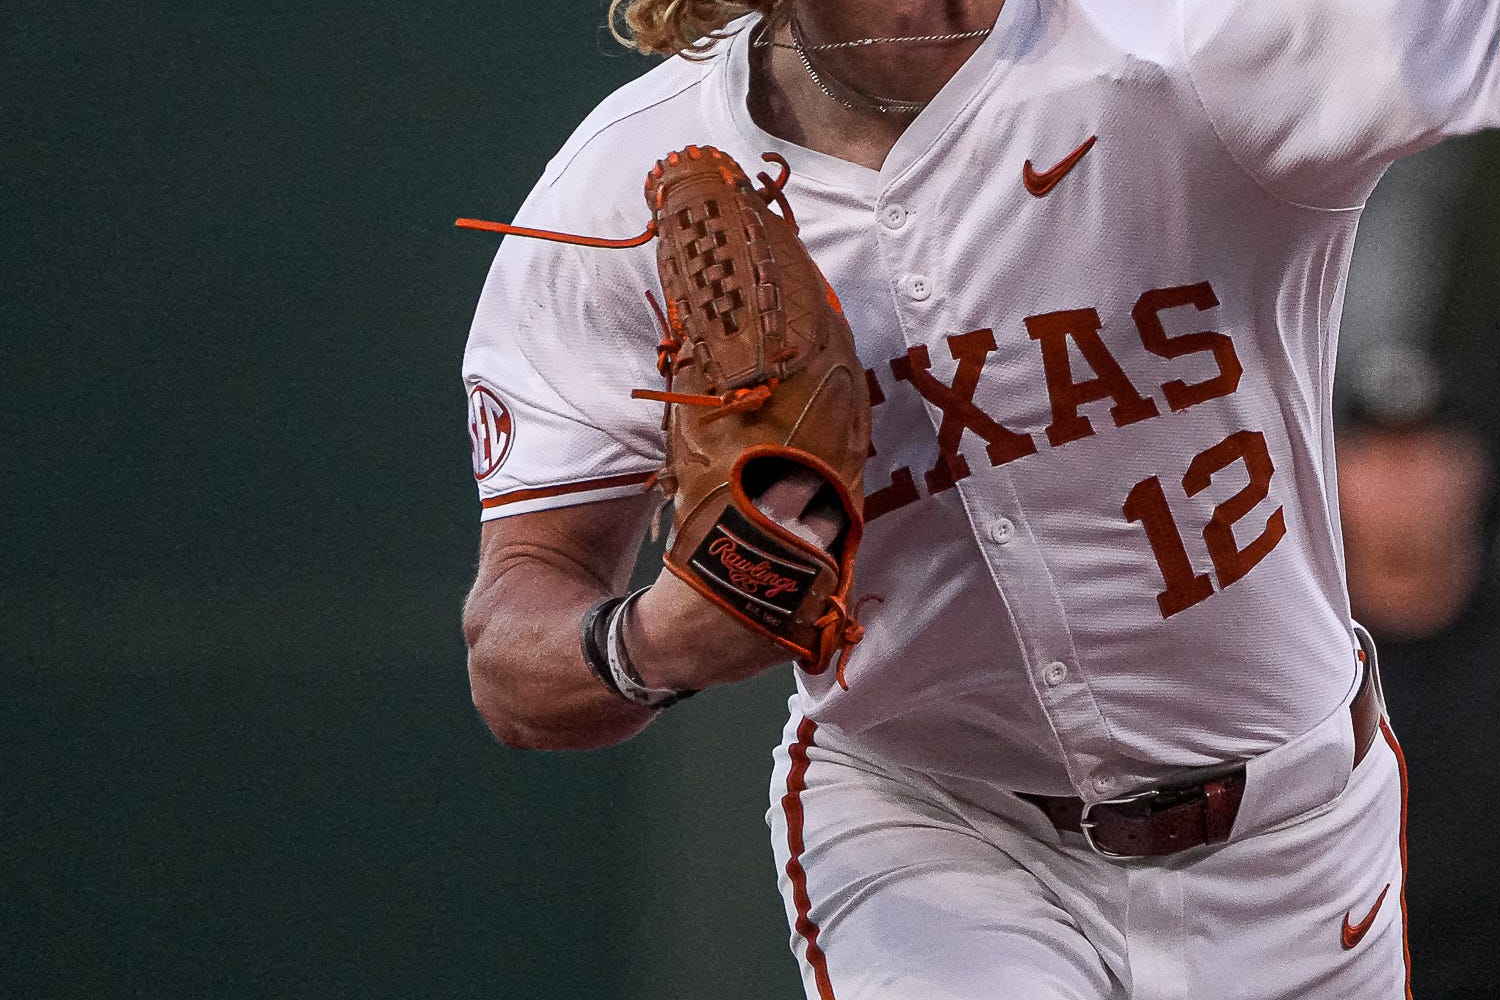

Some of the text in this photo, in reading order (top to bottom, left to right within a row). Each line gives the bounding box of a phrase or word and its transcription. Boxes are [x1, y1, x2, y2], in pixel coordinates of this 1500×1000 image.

[862, 280, 1243, 523] XAS
[709, 537, 799, 597] Rawlings
[1123, 430, 1286, 619] 12
